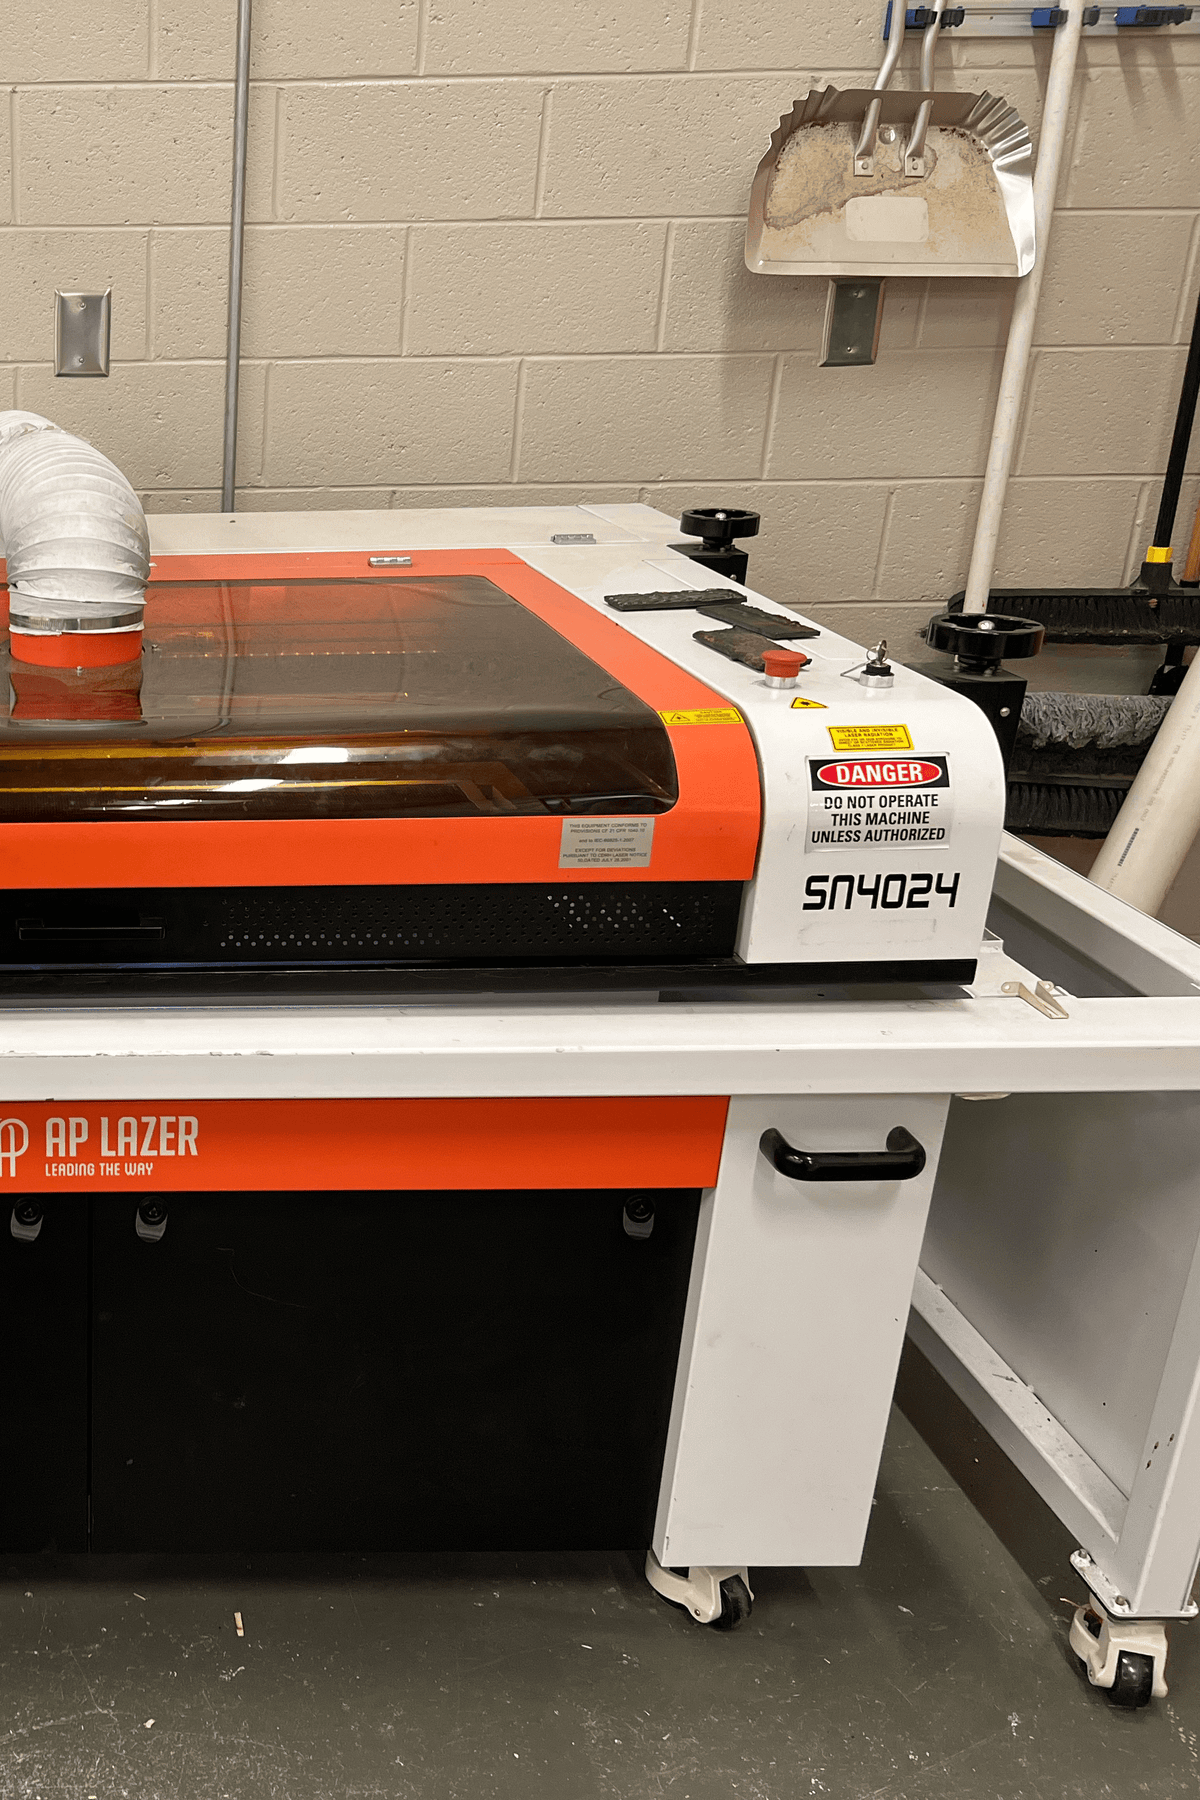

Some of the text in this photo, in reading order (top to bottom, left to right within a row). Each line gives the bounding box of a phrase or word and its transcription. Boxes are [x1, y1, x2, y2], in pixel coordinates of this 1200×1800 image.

[836, 764, 923, 783] DANGER
[824, 794, 938, 809] DO NOT OPERATE
[831, 812, 930, 826] THIS MACHINE
[812, 828, 946, 843] UNLESS AUTHORIZED
[802, 872, 961, 910] SN4024
[46, 1116, 199, 1157] AP LAZER
[45, 1162, 153, 1176] LEADING THE WAY
